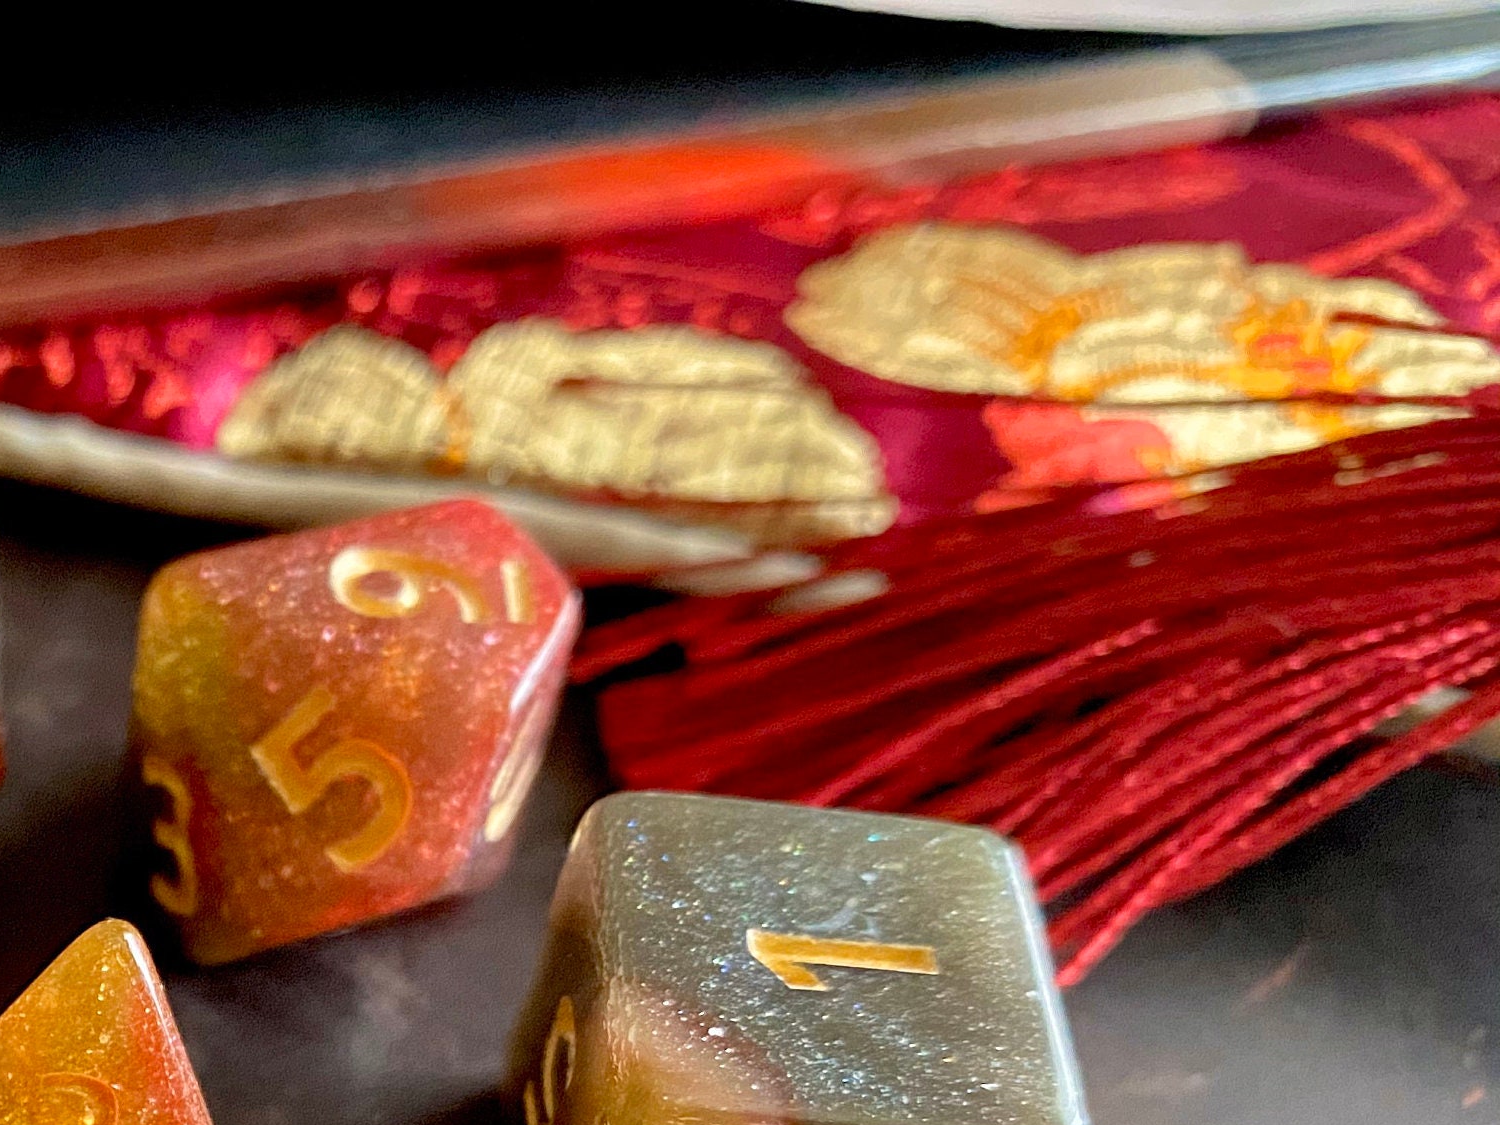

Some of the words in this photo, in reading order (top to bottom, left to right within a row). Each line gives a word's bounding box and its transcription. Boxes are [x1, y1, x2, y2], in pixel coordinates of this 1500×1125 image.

[143, 755, 199, 917] 3
[250, 687, 414, 874] 5
[746, 927, 940, 992] 1
